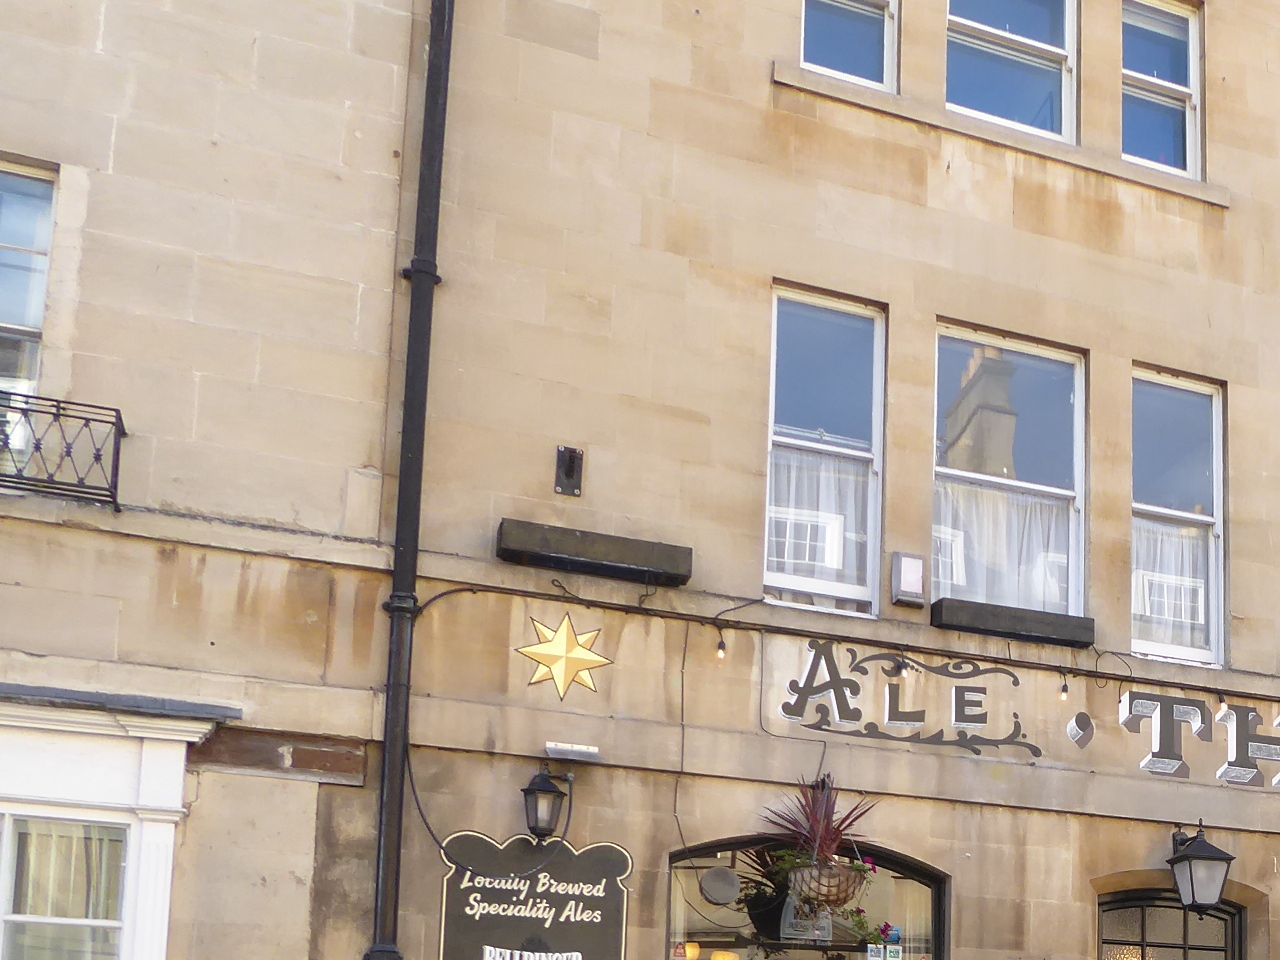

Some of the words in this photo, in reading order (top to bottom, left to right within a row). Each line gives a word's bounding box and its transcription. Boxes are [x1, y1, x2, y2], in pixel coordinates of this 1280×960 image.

[536, 872, 607, 897] Brewed
[464, 893, 556, 928] Speciality
[559, 900, 602, 923] Ales
